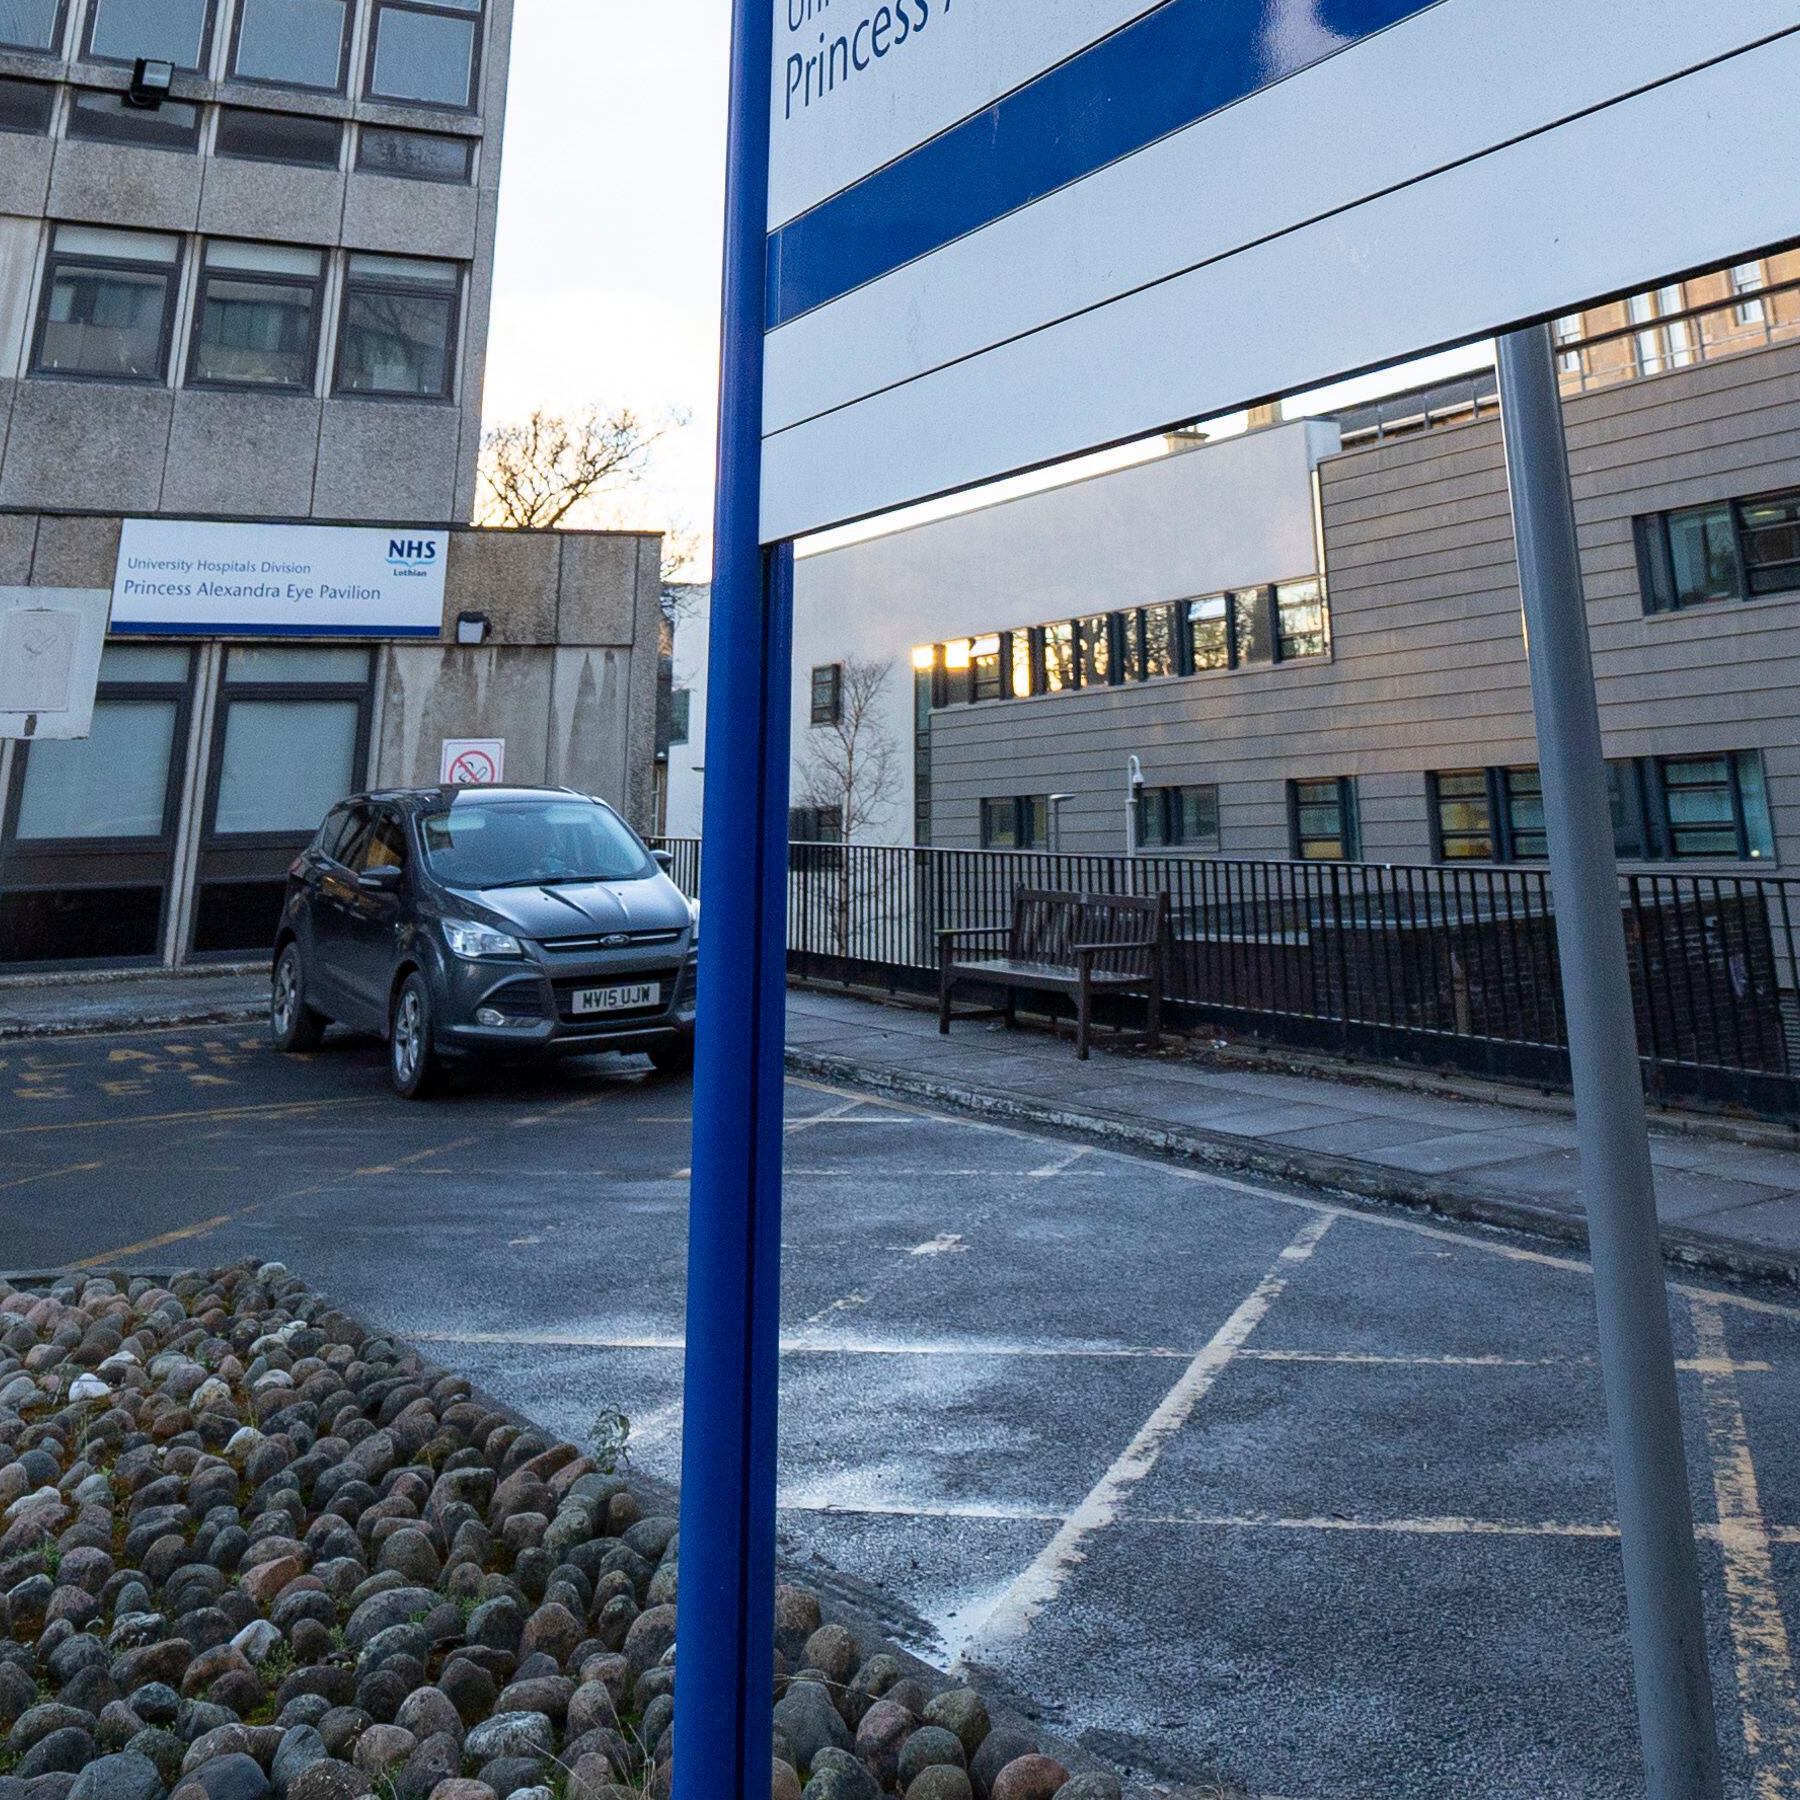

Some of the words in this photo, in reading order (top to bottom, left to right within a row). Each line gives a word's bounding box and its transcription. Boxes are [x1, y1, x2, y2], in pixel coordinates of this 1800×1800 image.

[388, 539, 437, 559] NHS
[127, 556, 193, 575] University
[196, 559, 257, 576] Hospitals
[260, 560, 312, 574] Division
[393, 567, 428, 578] Lothian
[123, 579, 192, 596] Princess
[196, 581, 281, 598] Alexandra
[286, 583, 315, 602] Eye
[319, 584, 382, 601] Pavilion
